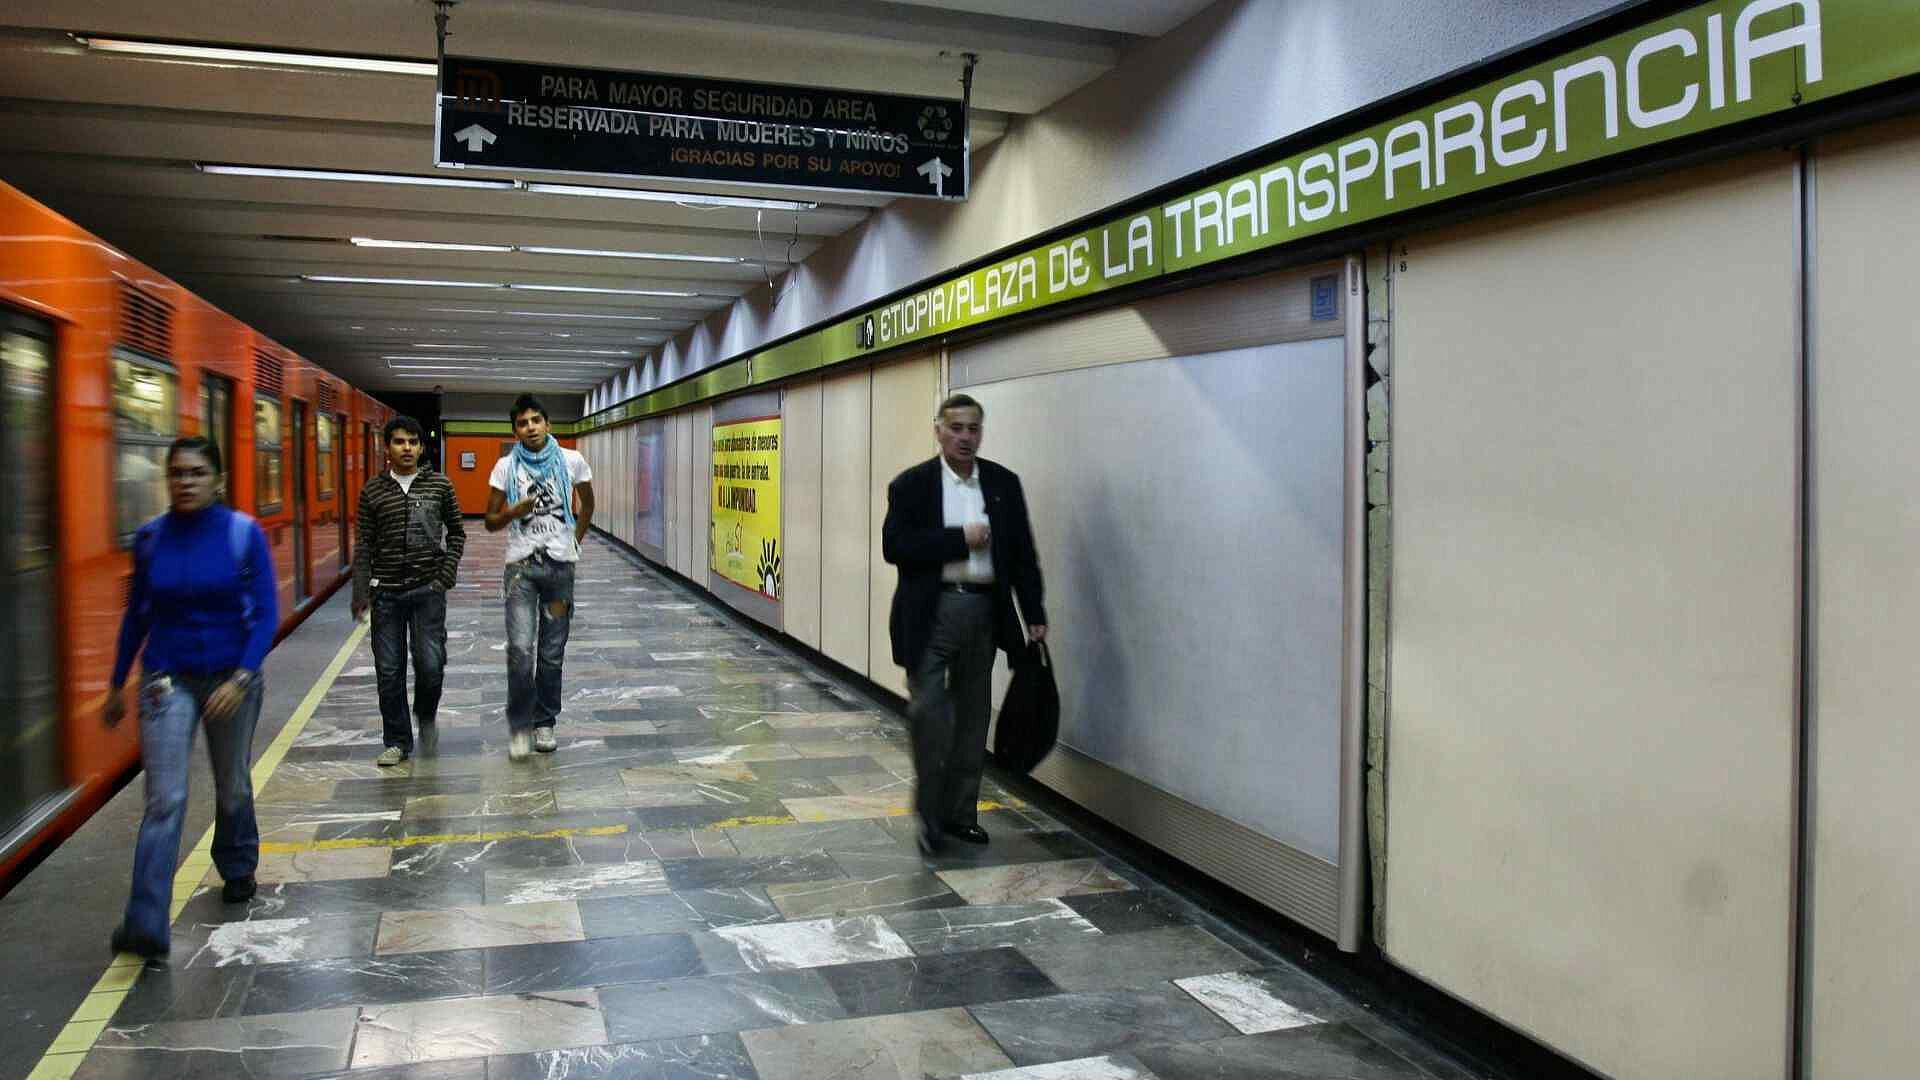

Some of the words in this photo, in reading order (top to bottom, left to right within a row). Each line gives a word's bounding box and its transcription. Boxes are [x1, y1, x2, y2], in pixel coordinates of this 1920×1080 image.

[541, 75, 598, 100] PARA
[609, 82, 682, 109] MAYOR
[693, 89, 813, 120] SEGURIDAD
[823, 98, 877, 122] AREA
[507, 104, 639, 135] RESERVADA
[649, 116, 705, 141] PARA
[717, 121, 815, 148] MUJERES
[826, 128, 837, 149] Y
[846, 126, 909, 154] NIÑOS
[763, 152, 799, 169] POR
[807, 157, 832, 172] SU
[879, 256, 1038, 342] ETIOPIA/PLAZA
[1048, 241, 1091, 295] DE
[1103, 216, 1154, 279] LA
[1164, 0, 1823, 259] TRANSPARENCIA
